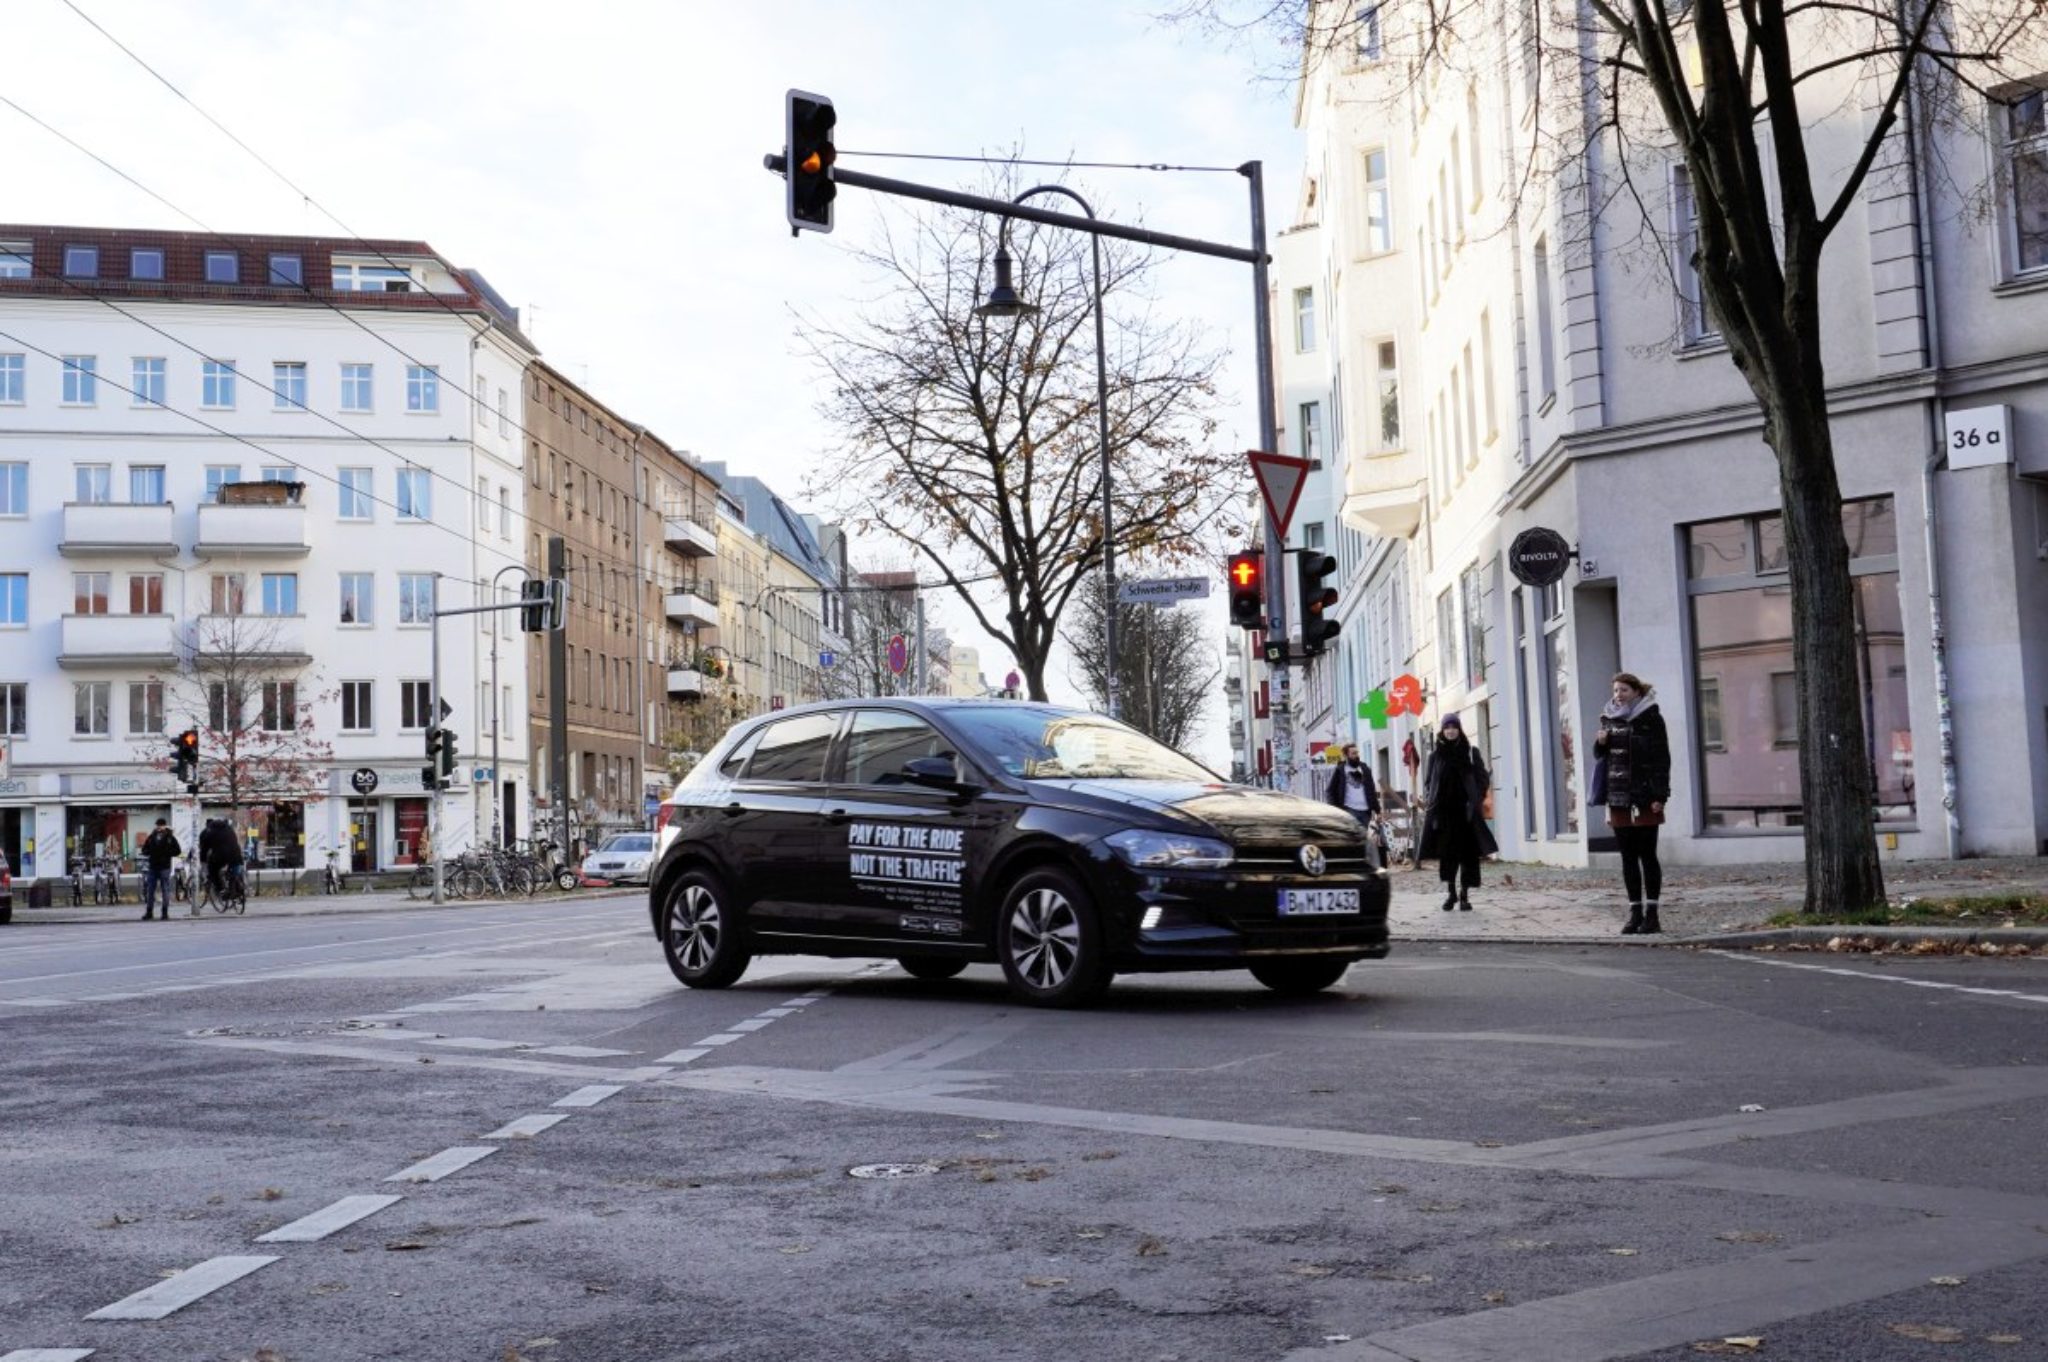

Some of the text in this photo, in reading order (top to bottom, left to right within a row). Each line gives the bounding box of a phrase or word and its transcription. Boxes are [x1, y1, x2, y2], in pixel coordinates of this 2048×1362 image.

[1953, 428, 2000, 449] 36 a
[1520, 552, 1559, 562] RIVOLTA
[1128, 584, 1173, 596] Schwedter
[848, 824, 964, 851] PAY FOR THE RIDE
[850, 853, 876, 875] NOT
[878, 855, 902, 877] THE
[1327, 891, 1358, 911] 2432
